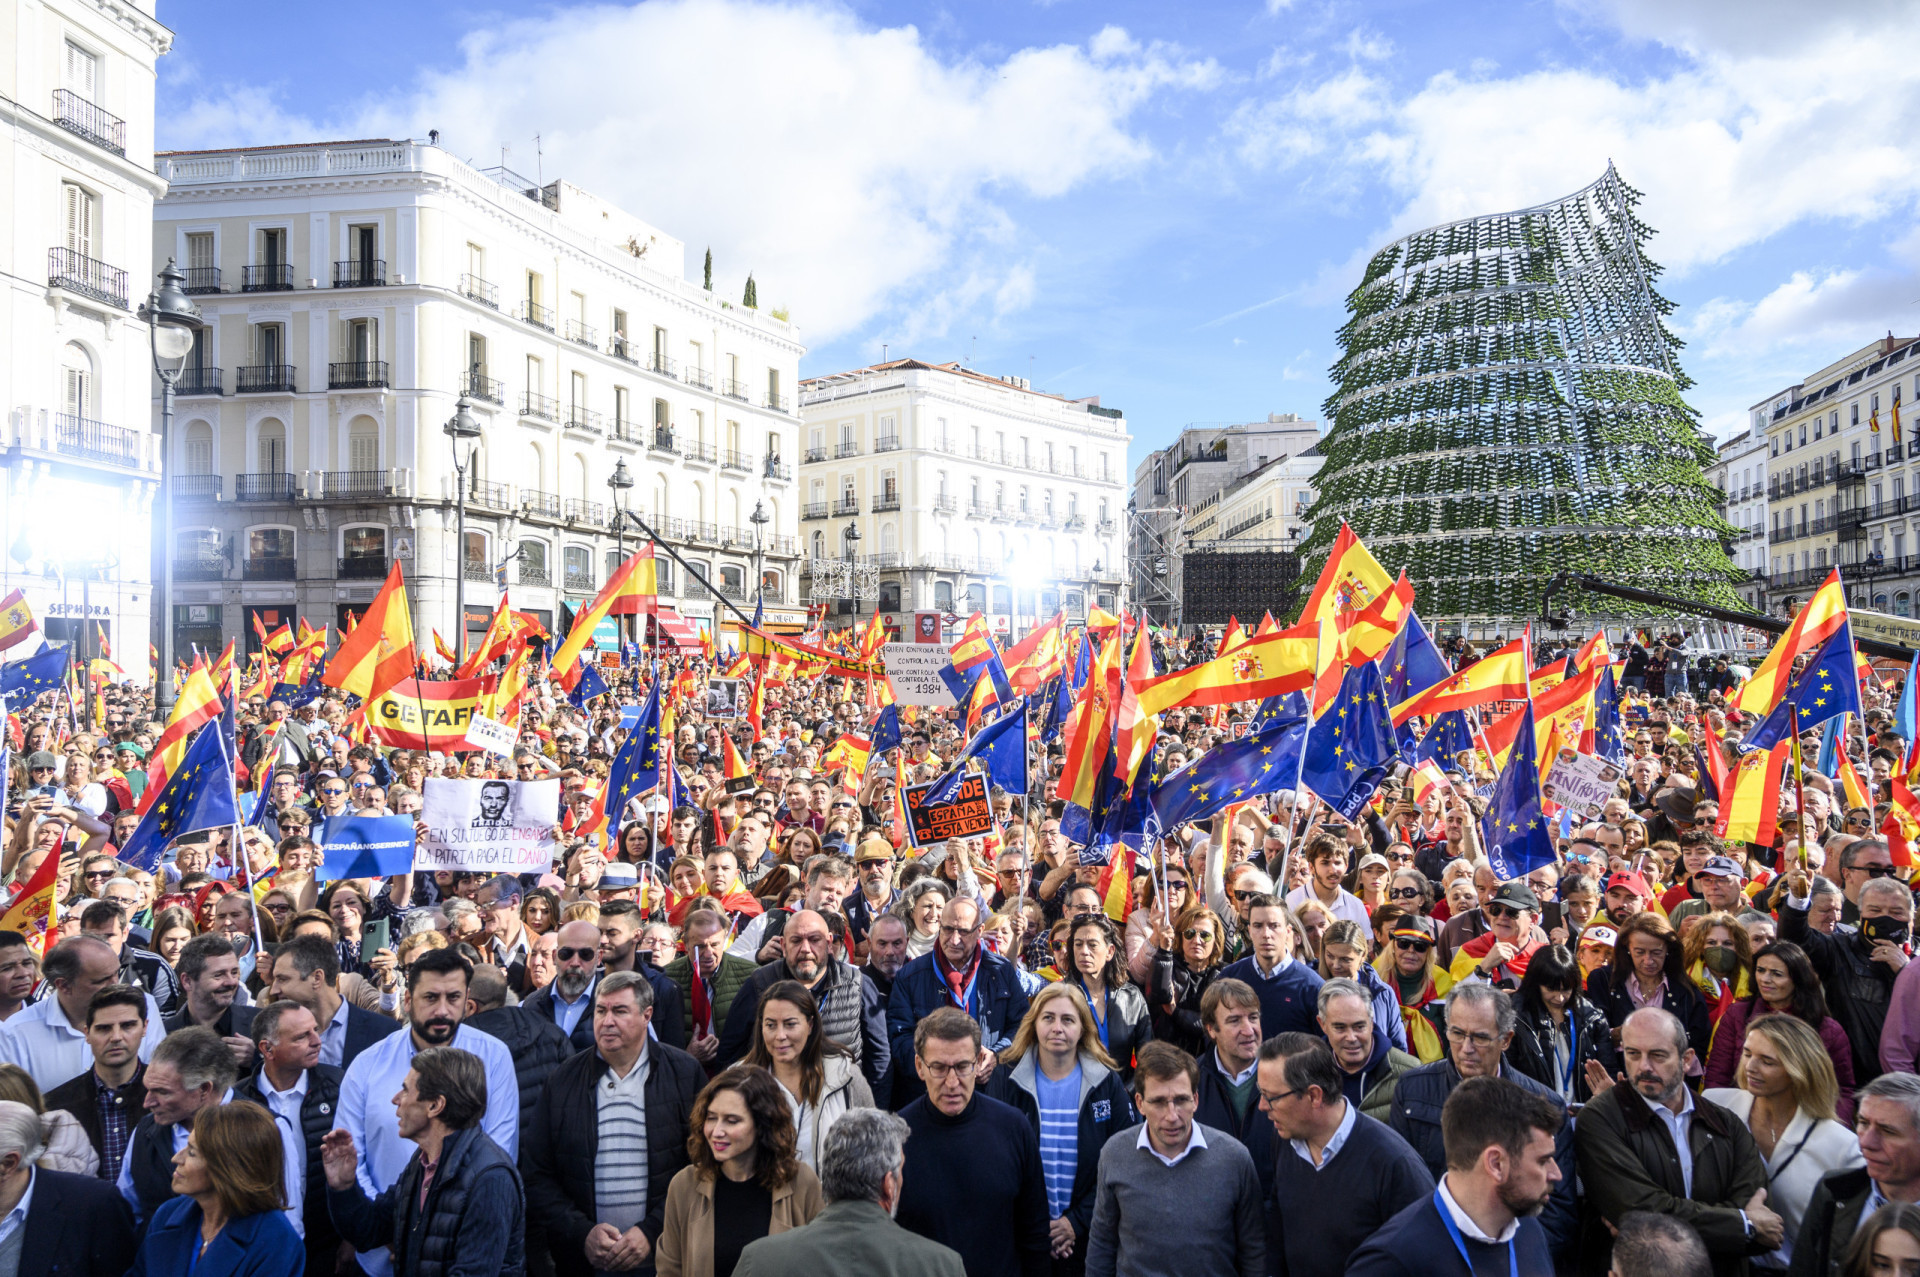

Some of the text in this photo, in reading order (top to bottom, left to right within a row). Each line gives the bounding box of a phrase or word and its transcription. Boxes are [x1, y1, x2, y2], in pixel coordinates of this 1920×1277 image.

[49, 603, 110, 616] SEPHORA
[464, 612, 488, 623] Orange
[936, 647, 946, 655] EL
[906, 668, 935, 676] CONTROLA
[915, 684, 941, 694] 1984
[1480, 701, 1526, 713] SE VEND
[1343, 792, 1362, 816] ppe
[930, 804, 975, 821] ESPAÑA
[430, 826, 549, 843] EN SU JUEGO DE ENGAÑO
[933, 822, 963, 836] ESTA
[324, 841, 410, 851] #ESPAÑANOSERINDE
[419, 847, 547, 865] LA PATRIA PAGA EL DAÑO
[1492, 859, 1511, 880] ppe
